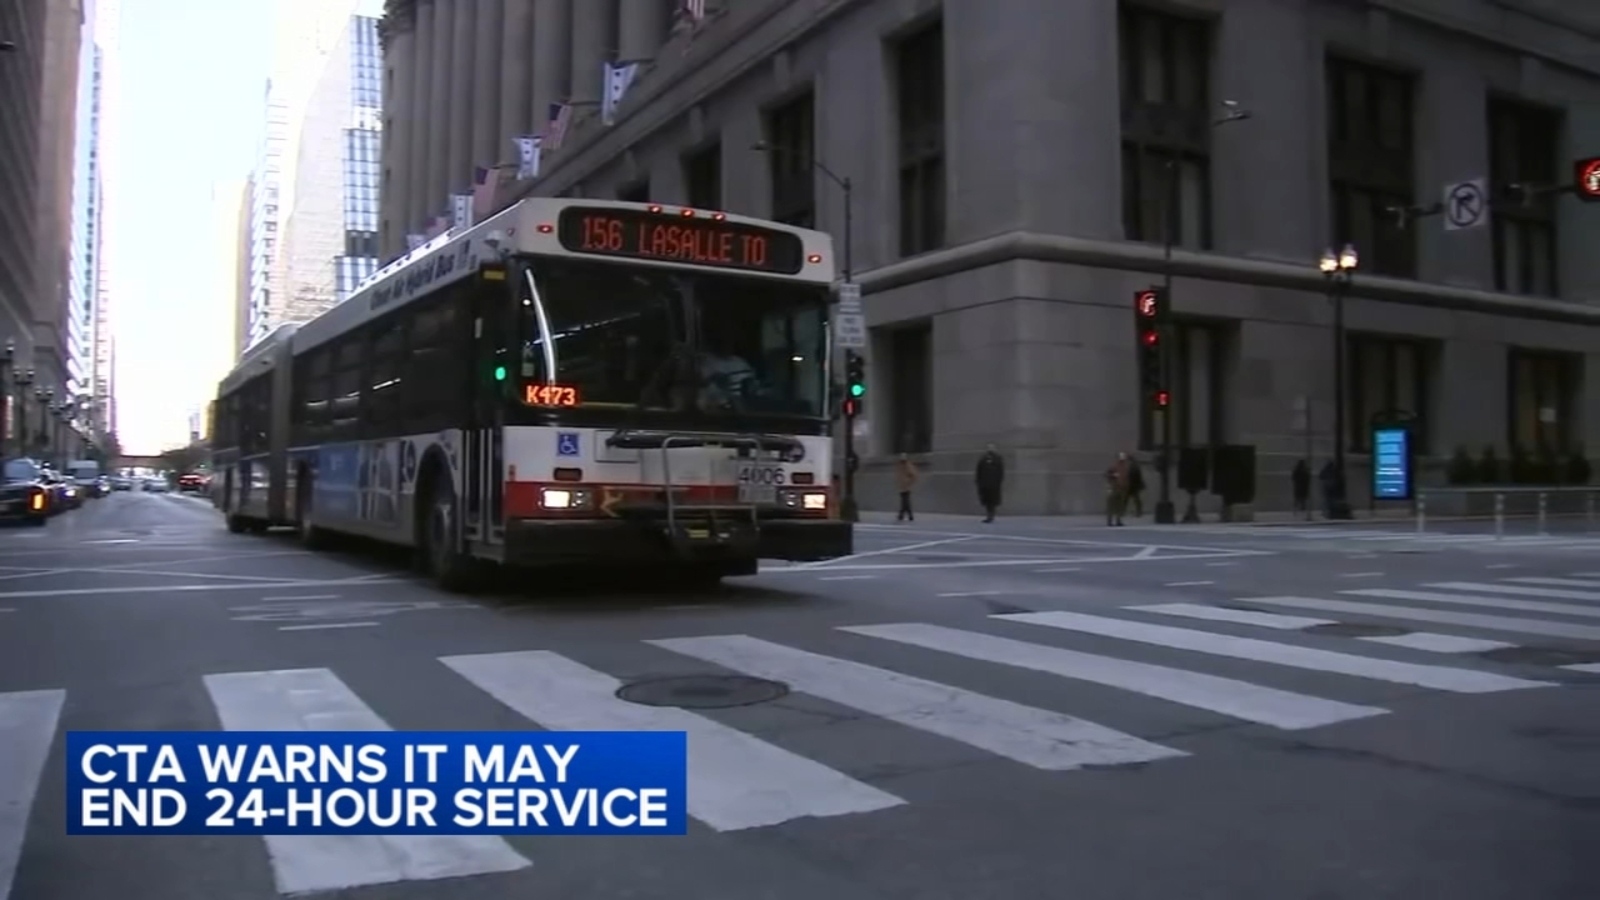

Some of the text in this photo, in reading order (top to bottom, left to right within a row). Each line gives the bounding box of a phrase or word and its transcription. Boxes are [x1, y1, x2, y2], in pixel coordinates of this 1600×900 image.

[581, 216, 766, 266] 156 LASALLE TO
[526, 385, 576, 405] K473
[739, 467, 785, 485] 4006
